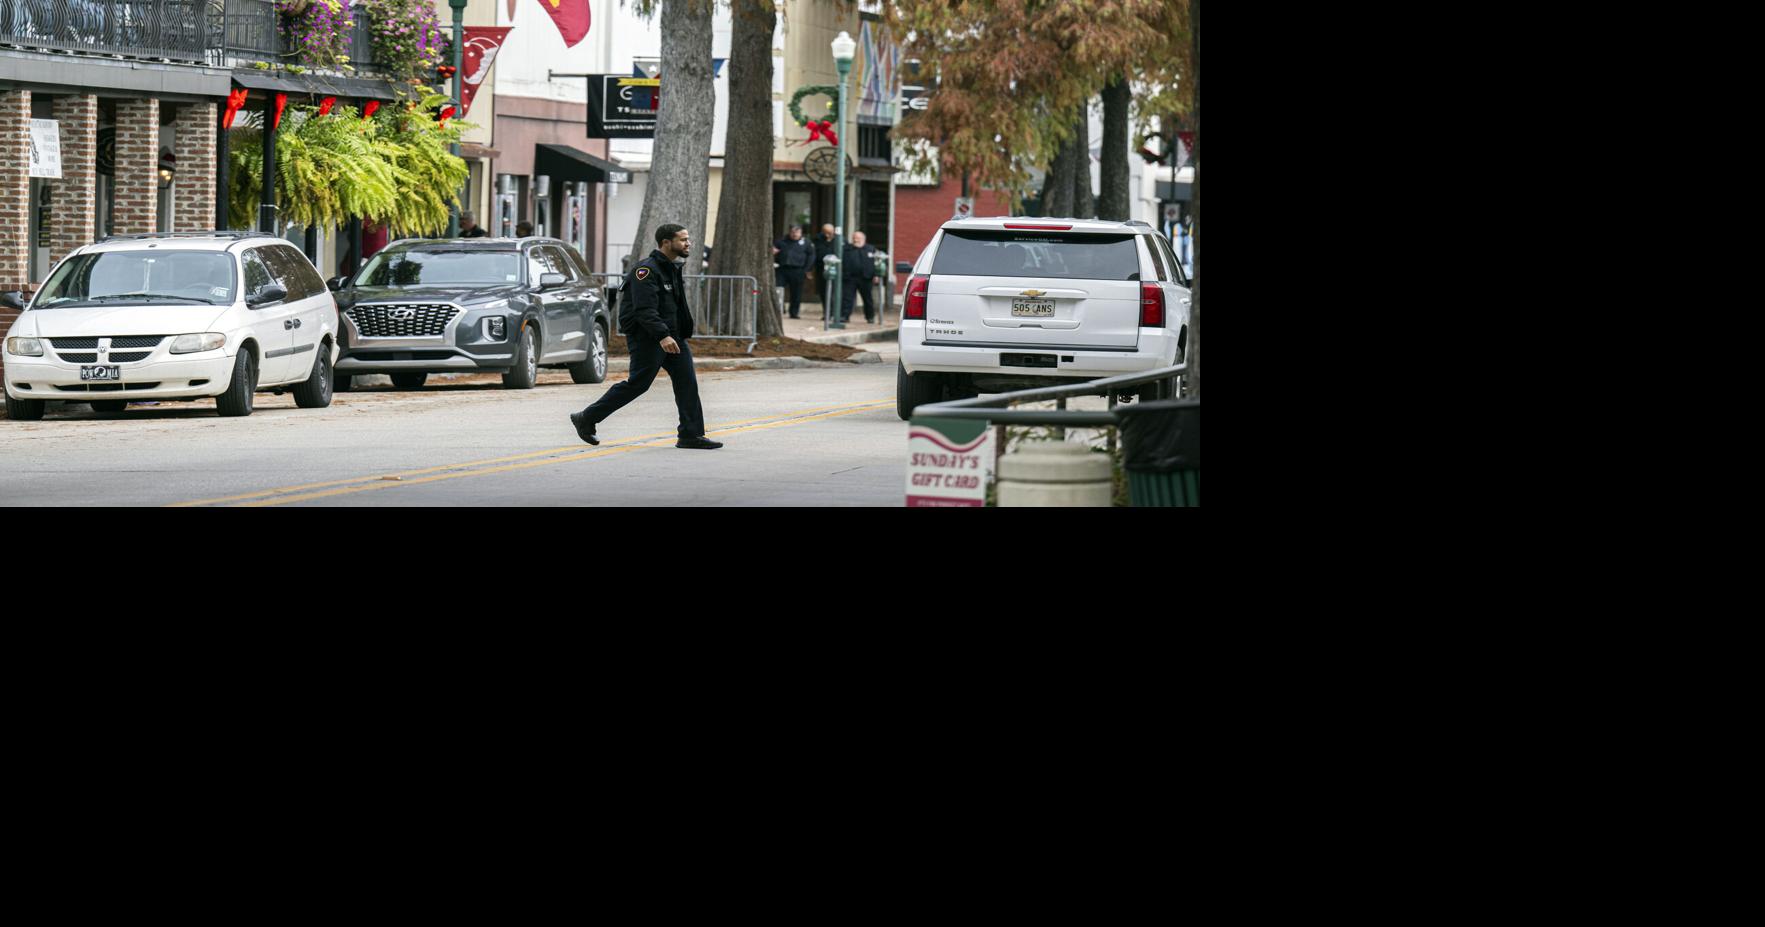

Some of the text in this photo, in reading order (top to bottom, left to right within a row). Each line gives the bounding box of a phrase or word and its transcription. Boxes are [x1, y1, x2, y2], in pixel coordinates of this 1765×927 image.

[1014, 303, 1052, 313] 505 ANS
[911, 452, 980, 469] SUNDAY'S
[912, 472, 980, 490] GIFT CARD
